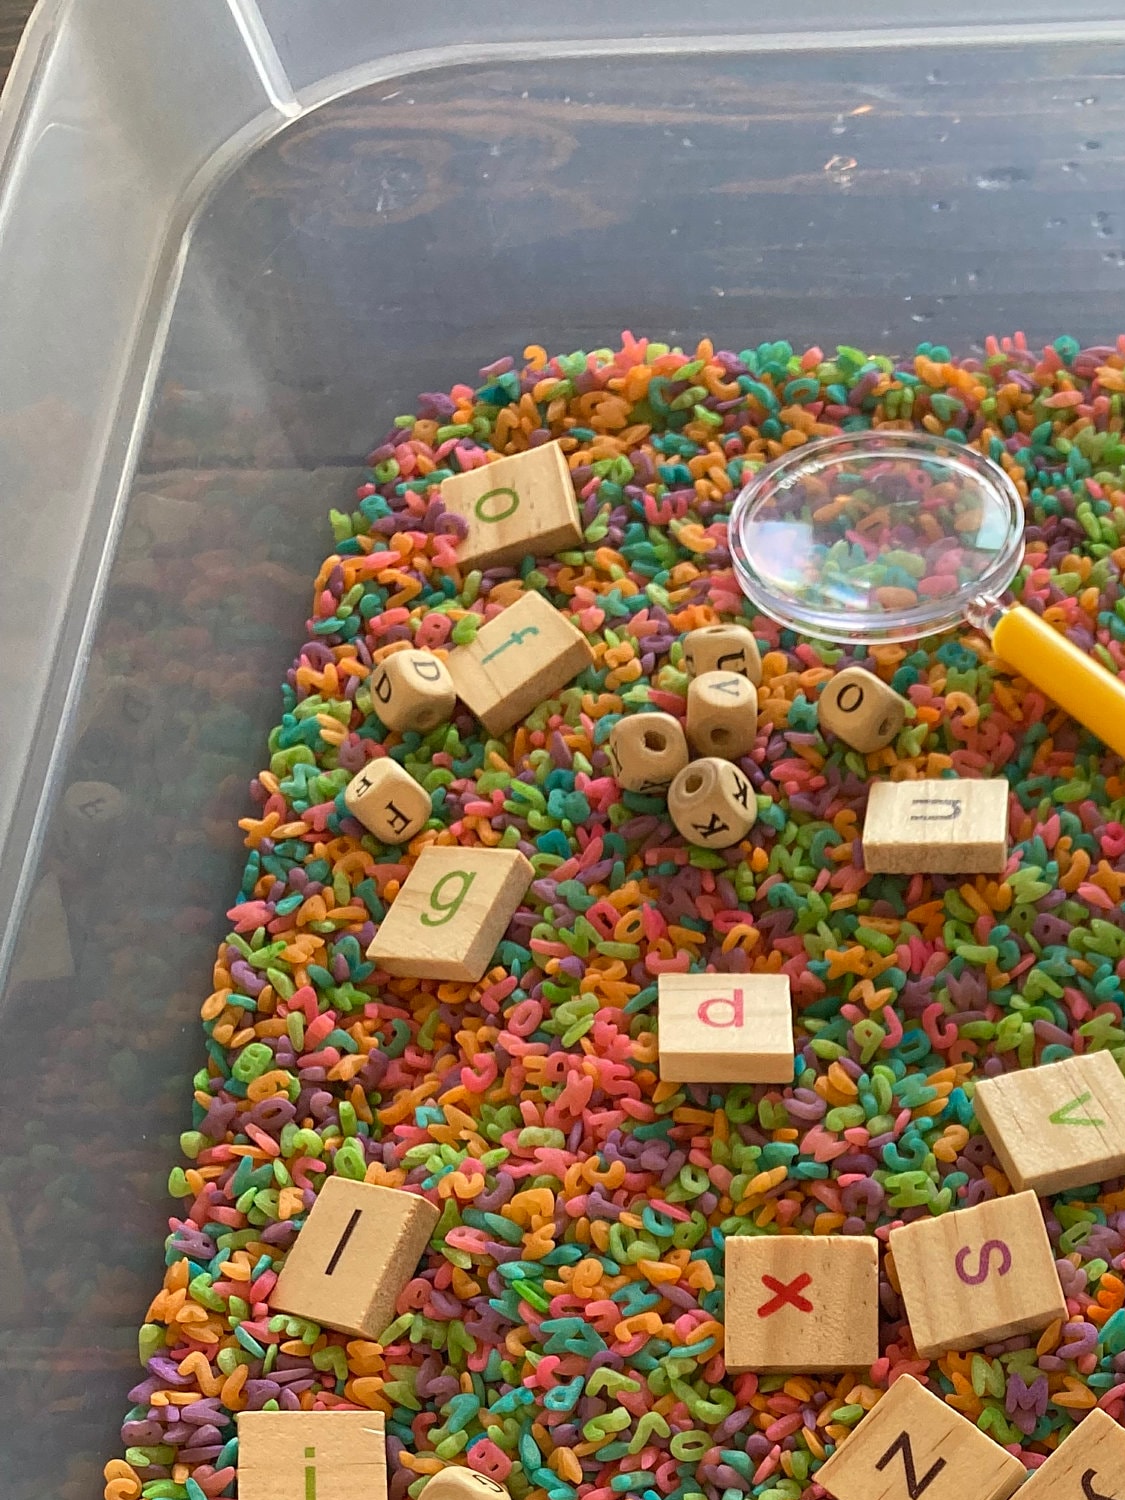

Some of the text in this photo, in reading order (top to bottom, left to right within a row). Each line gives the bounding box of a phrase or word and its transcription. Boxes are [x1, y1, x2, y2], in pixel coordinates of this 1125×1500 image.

[481, 626, 539, 665] f
[375, 671, 392, 704] D
[410, 658, 441, 682] D
[384, 799, 413, 835] F
[419, 870, 478, 928] g
[697, 988, 744, 1029] d
